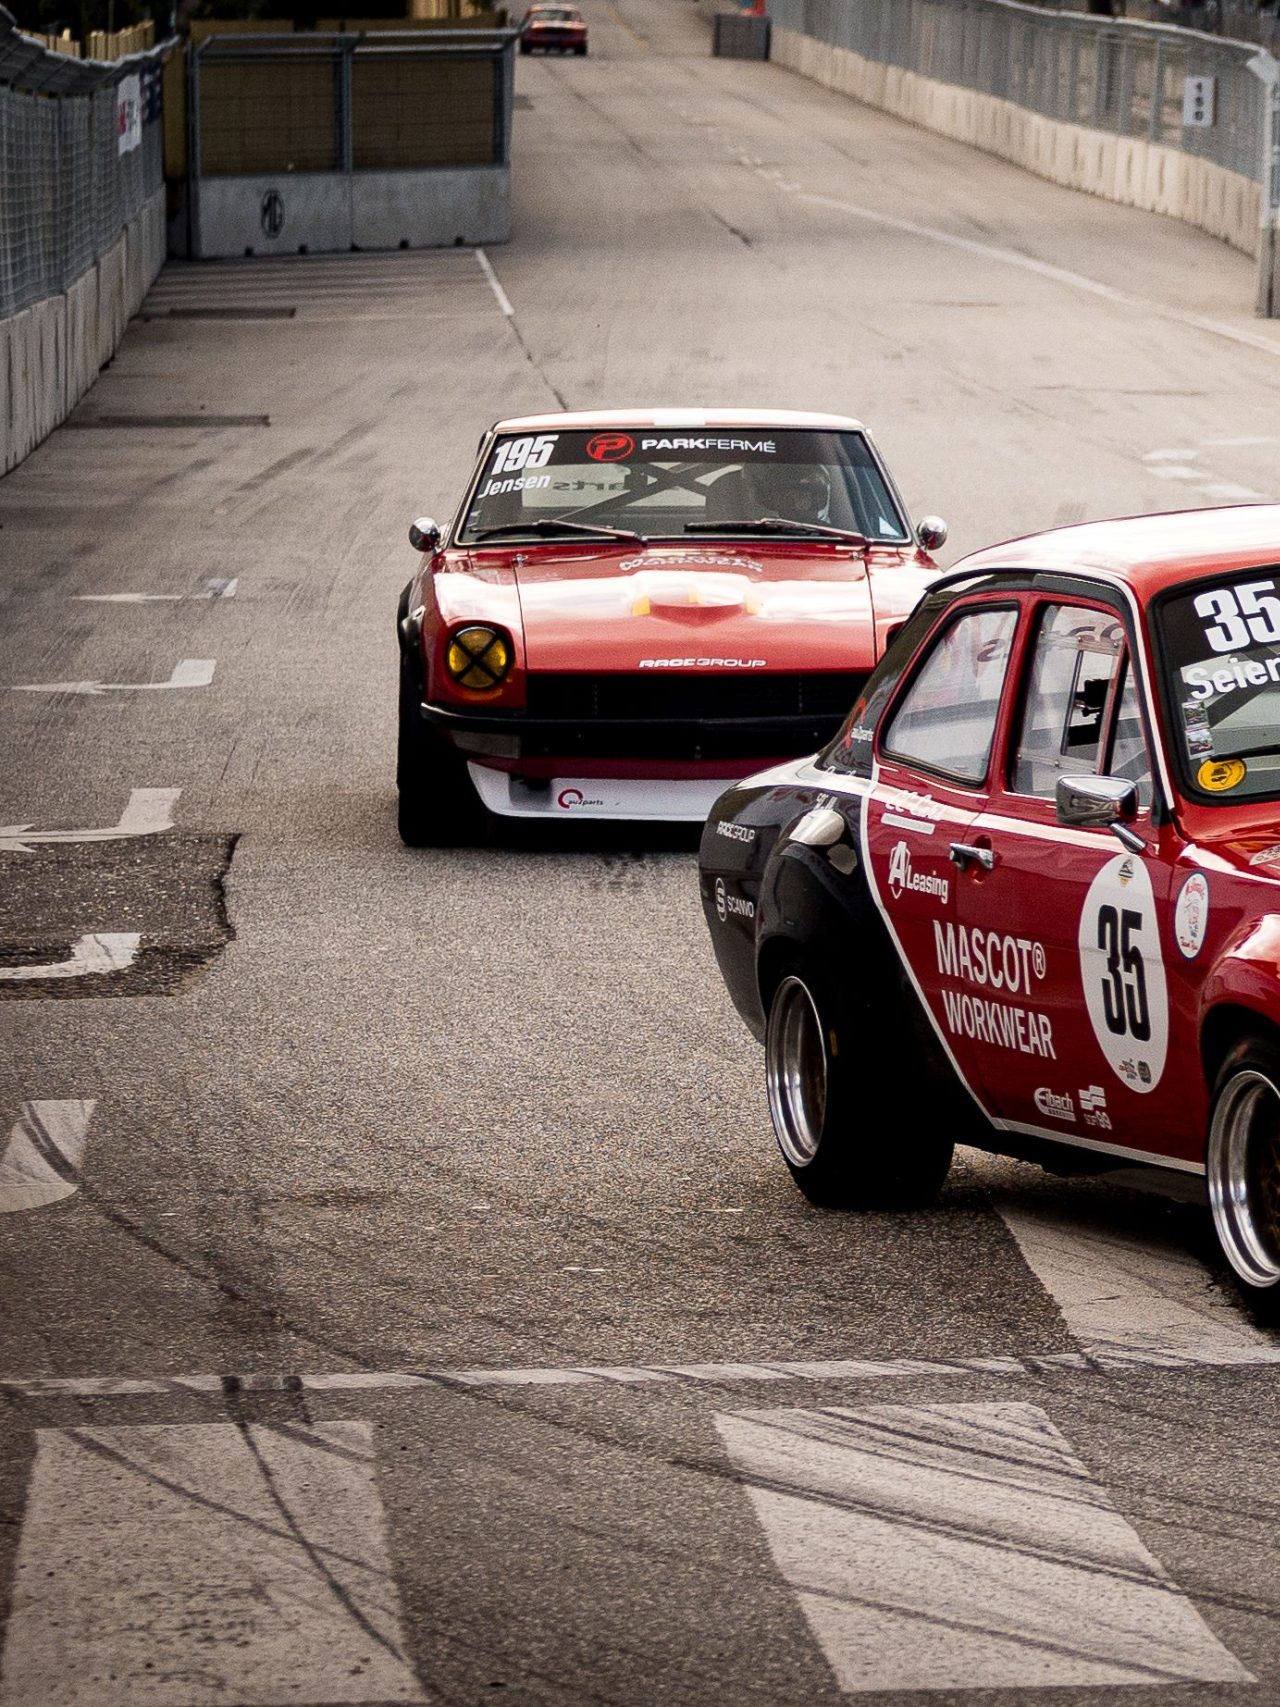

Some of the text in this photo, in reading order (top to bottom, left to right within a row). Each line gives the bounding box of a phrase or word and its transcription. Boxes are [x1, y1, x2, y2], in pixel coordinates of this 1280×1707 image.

[491, 435, 559, 475] 195
[641, 438, 776, 453] PARKFERMÉ
[477, 475, 550, 499] Jensen
[639, 658, 766, 668] RACEGROUP
[906, 865, 948, 904] Leasing
[1098, 904, 1151, 1042] 35
[942, 990, 1057, 1060] WORKWEAR
